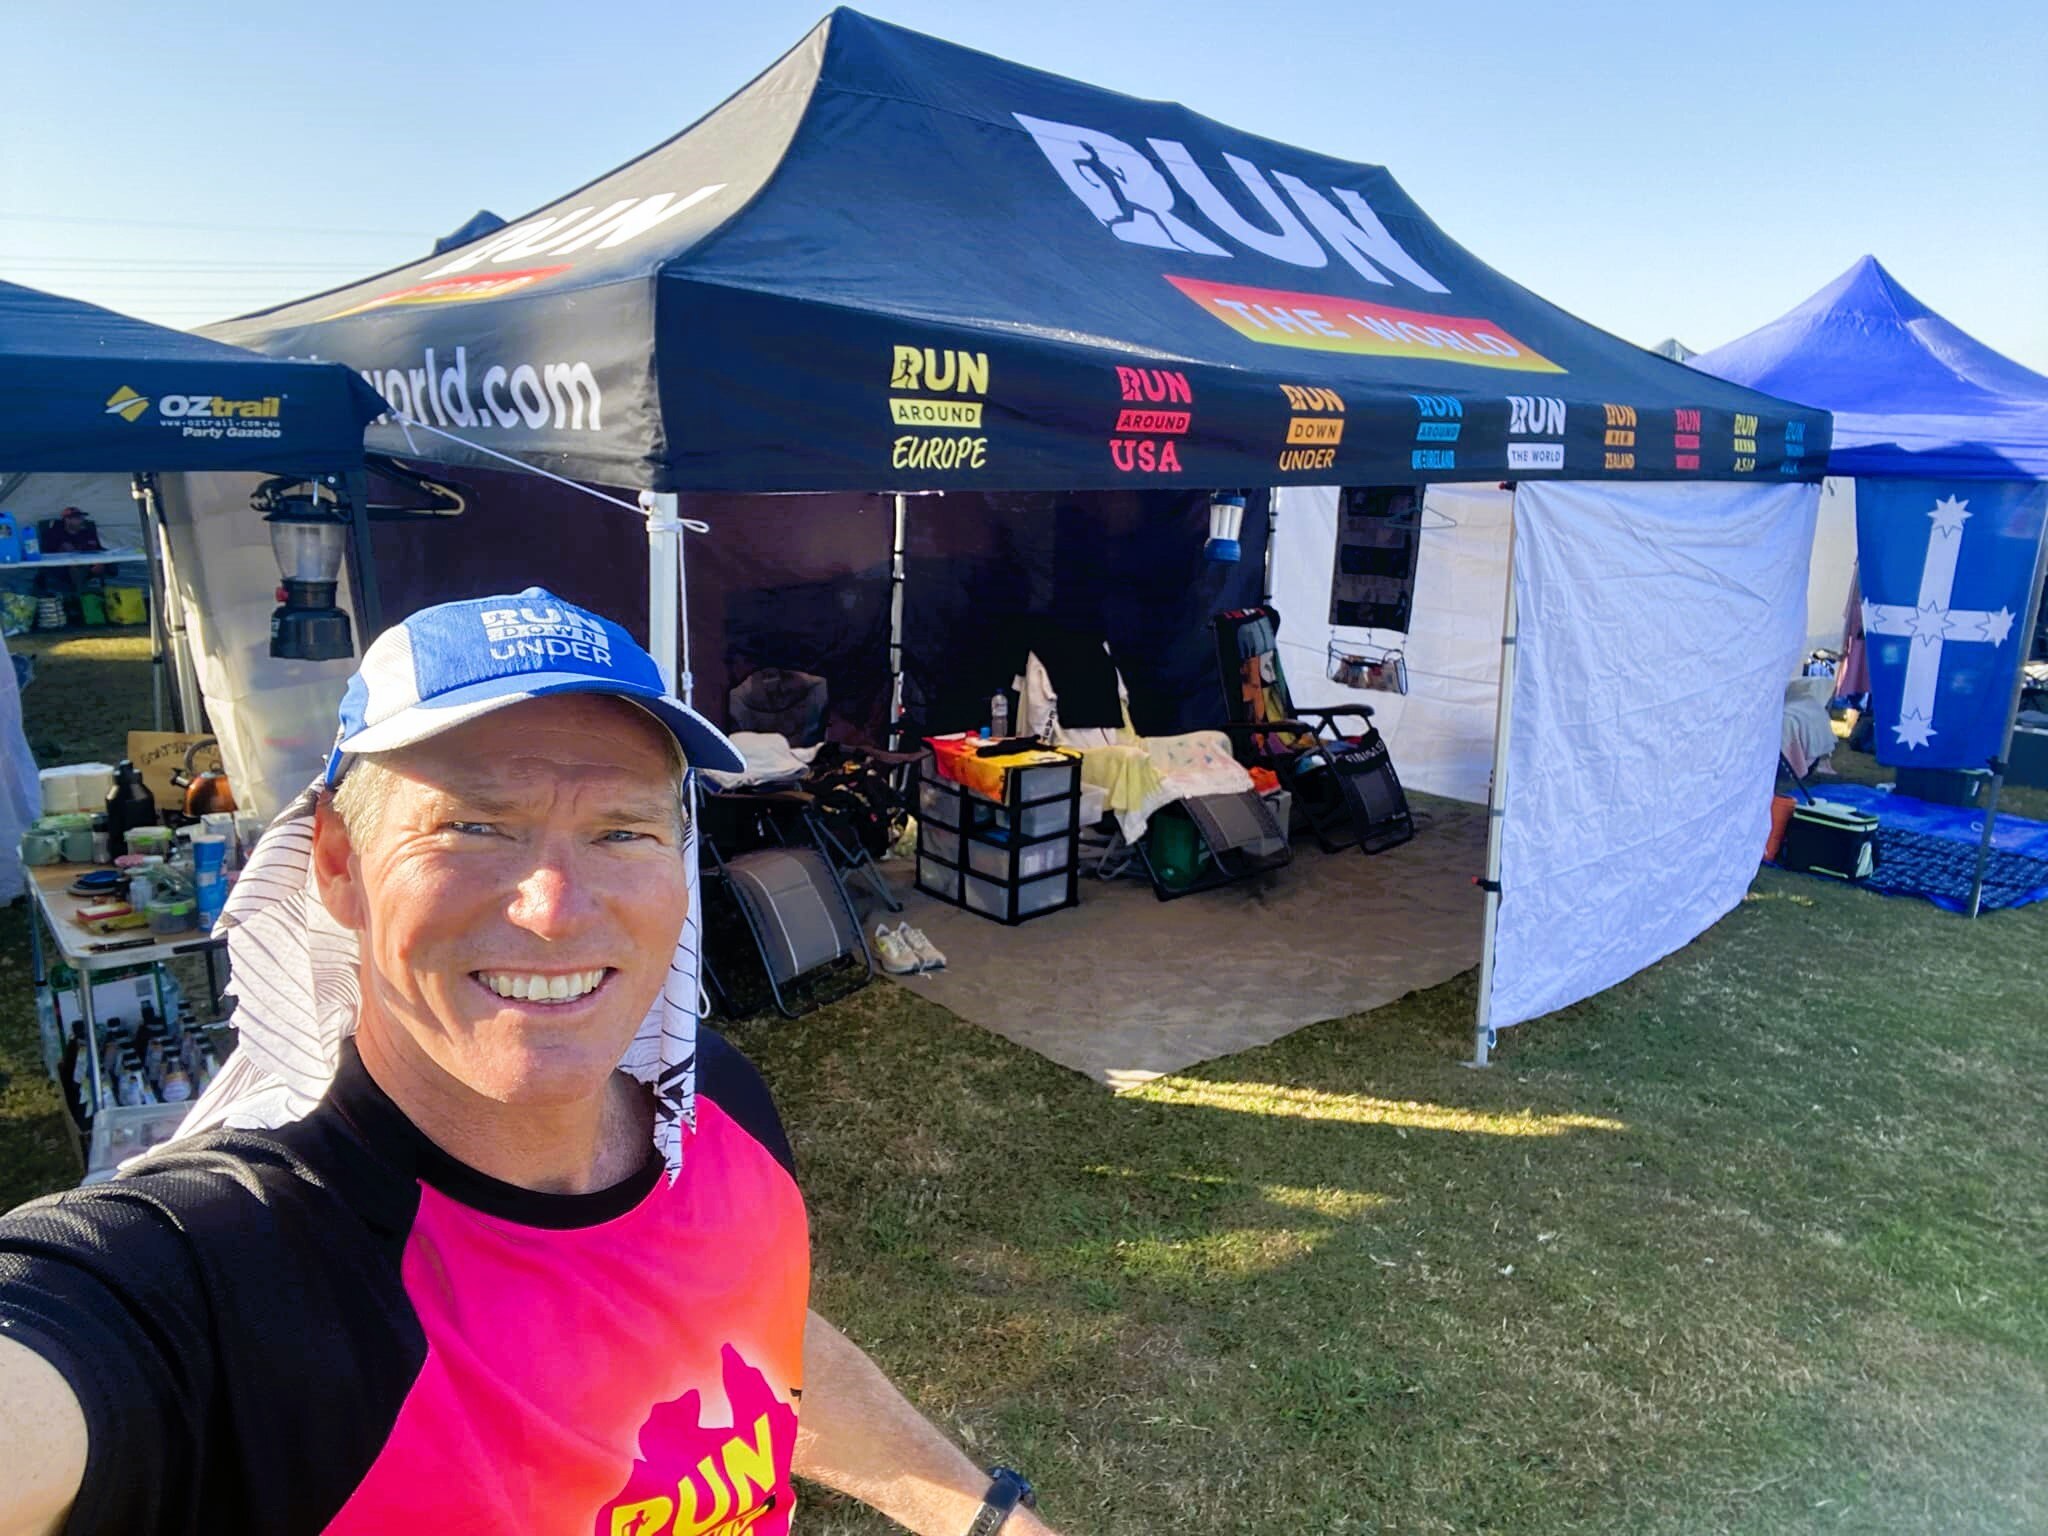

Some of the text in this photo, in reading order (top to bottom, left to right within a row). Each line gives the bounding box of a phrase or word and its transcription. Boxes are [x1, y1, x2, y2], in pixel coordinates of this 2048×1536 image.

[1011, 112, 1452, 294] RUN
[1214, 298, 1520, 358] THE WORLD
[890, 345, 989, 395] RUN
[1115, 365, 1193, 404] RUN
[159, 394, 281, 418] OZtrail
[1279, 384, 1345, 412] RUN
[1407, 393, 1464, 417] RUN
[898, 404, 977, 423] AROUND
[1120, 414, 1187, 431] AROUND
[1506, 396, 1567, 435] RUN
[1603, 404, 1637, 427] RUN
[1675, 409, 1700, 433] RUN
[1734, 414, 1758, 437] RUN
[182, 427, 281, 439] Party Gazebo
[1294, 424, 1338, 439] DOWN
[892, 435, 989, 471] EUROPE
[1110, 440, 1182, 472] USA
[1279, 449, 1335, 471] UNDER
[1511, 451, 1561, 463] THE WORLD
[480, 607, 607, 635] RUN
[503, 625, 598, 645] DOWN
[490, 638, 613, 668] UNDER
